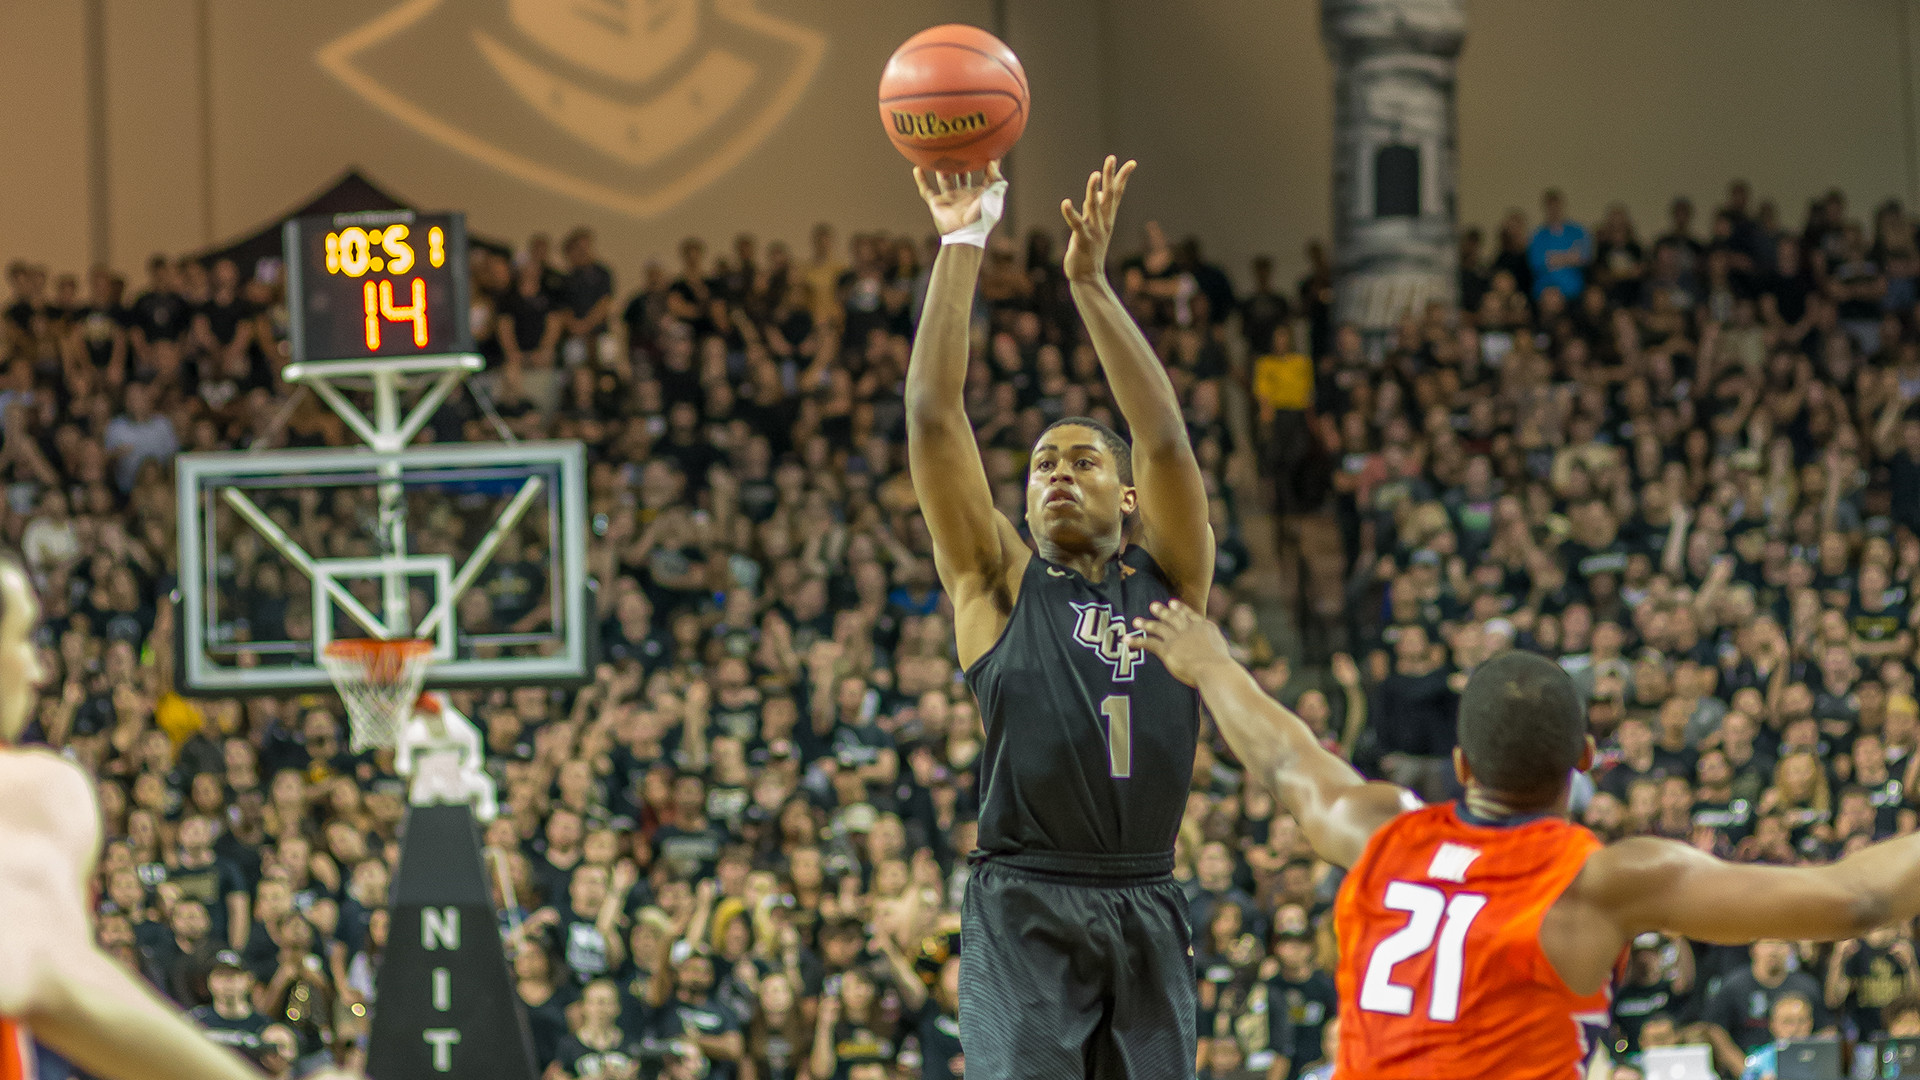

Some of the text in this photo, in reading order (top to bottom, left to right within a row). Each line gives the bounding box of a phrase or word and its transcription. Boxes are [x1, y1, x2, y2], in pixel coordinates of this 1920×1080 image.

[890, 110, 988, 138] Wilson
[325, 224, 445, 277] 10:51
[363, 277, 429, 352] 14
[1101, 694, 1131, 778] 1
[1359, 880, 1488, 1022] 21
